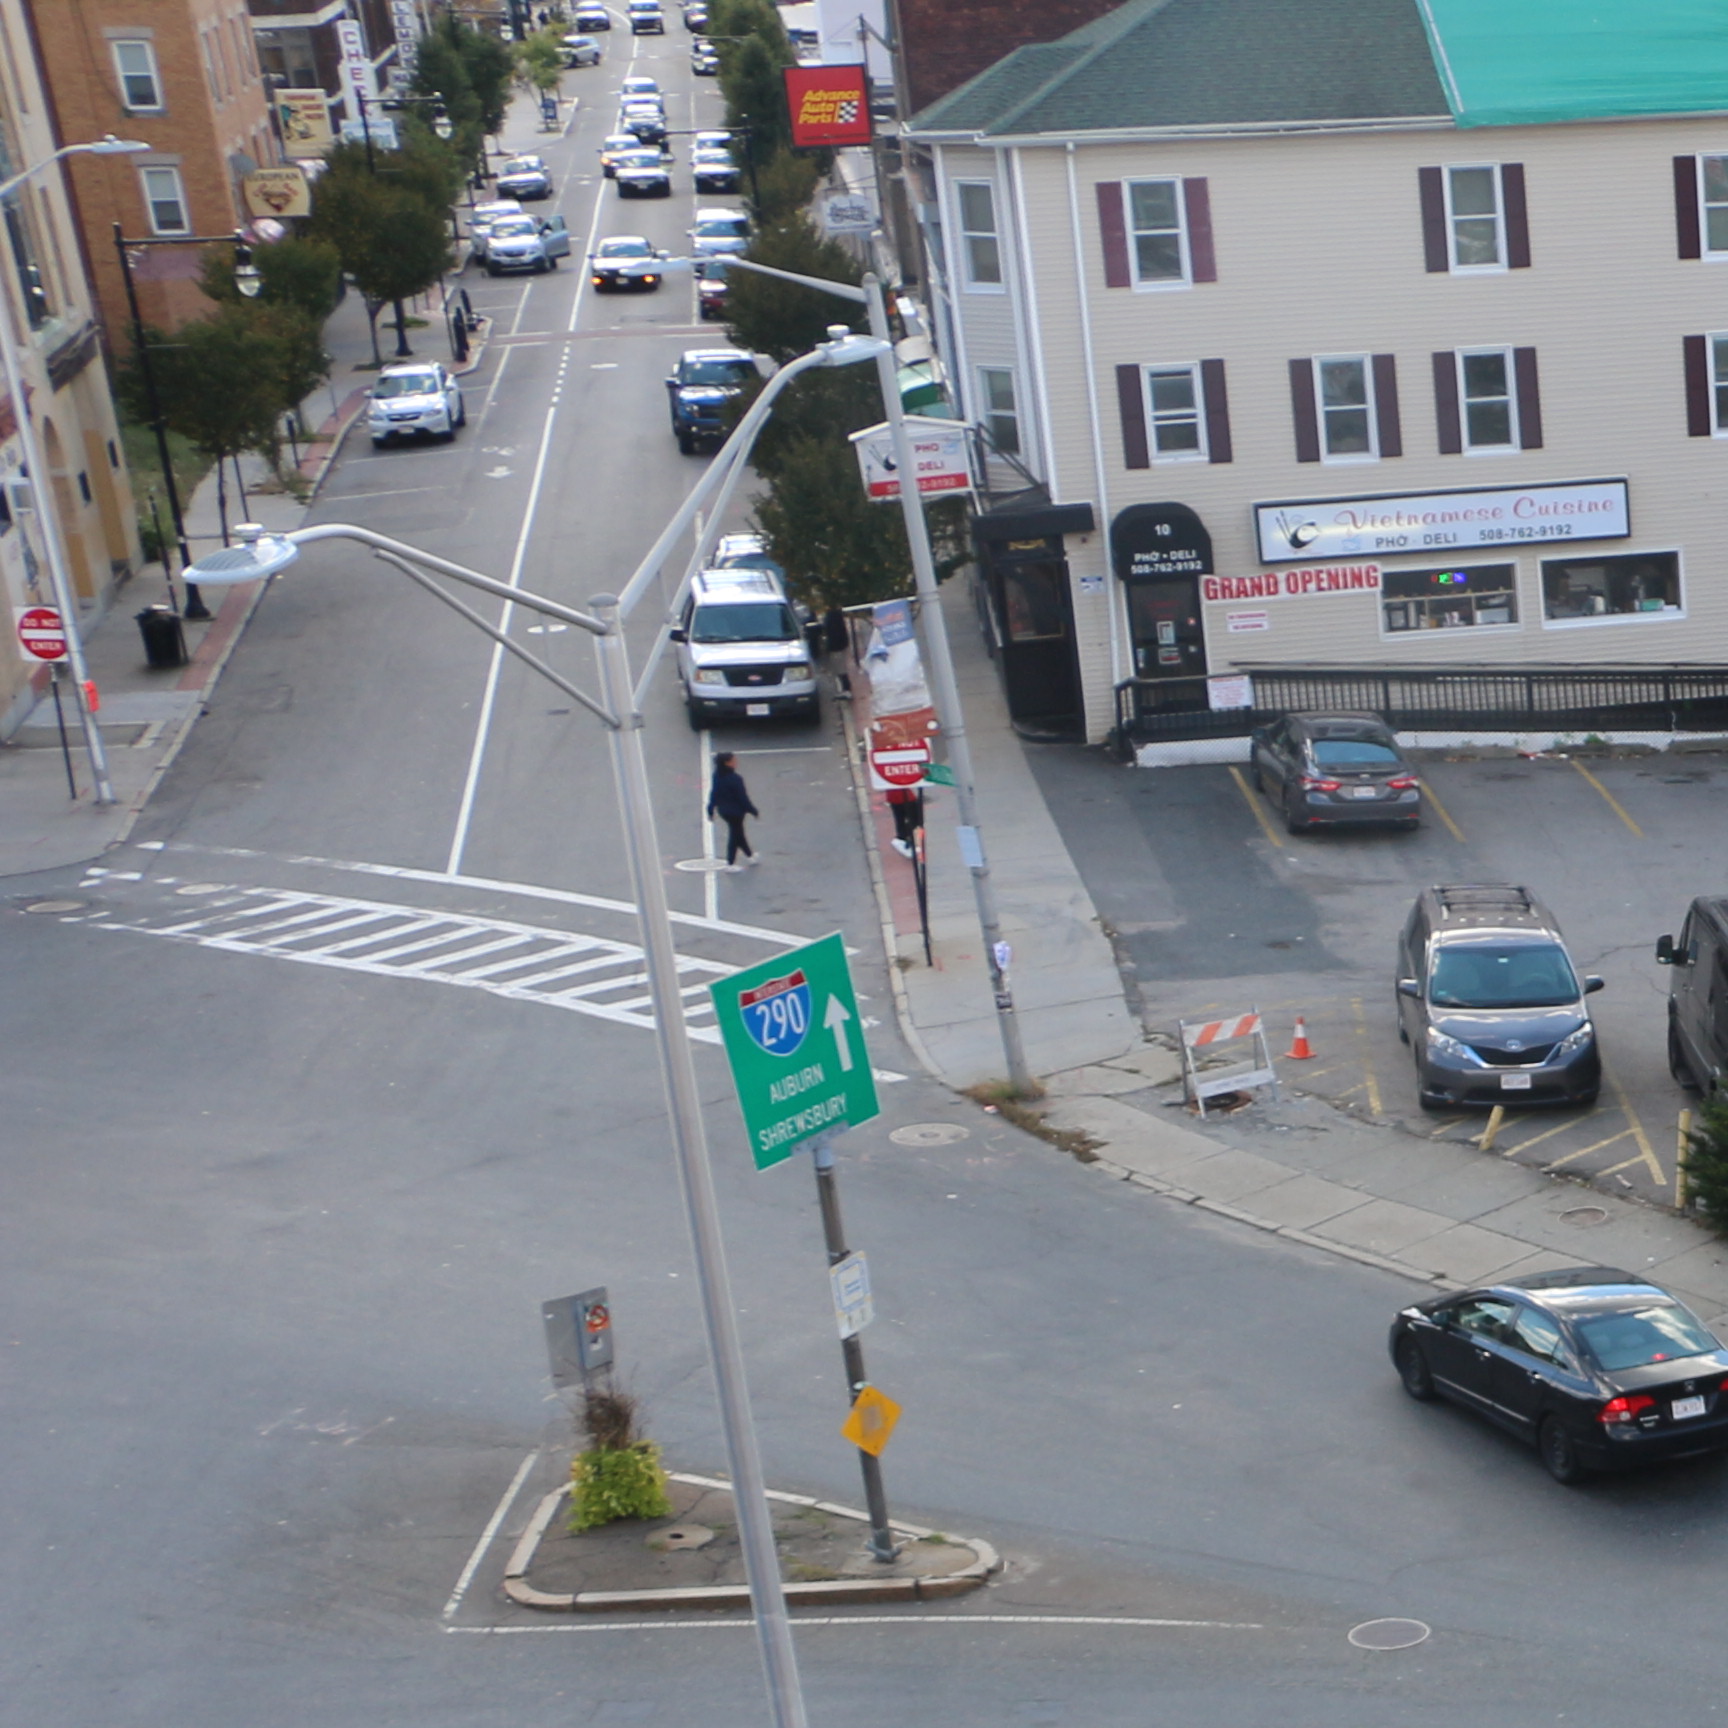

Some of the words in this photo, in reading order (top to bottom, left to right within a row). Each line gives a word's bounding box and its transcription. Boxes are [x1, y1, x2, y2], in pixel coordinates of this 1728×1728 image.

[802, 90, 861, 102] Advance
[801, 102, 835, 113] Auto
[798, 112, 833, 124] Parts
[1334, 505, 1504, 531] Vietnamese
[1512, 496, 1615, 520] Cuisine
[1154, 523, 1172, 536] 10
[1422, 532, 1458, 546] DELI
[1478, 524, 1573, 542] 508-762-9192
[1169, 549, 1198, 561] DELI
[1203, 572, 1280, 601] GRAND
[1285, 564, 1380, 595] OPENING
[884, 763, 920, 777] ENTER
[755, 992, 805, 1047] 290
[769, 1063, 826, 1105] AUBURN
[758, 1092, 848, 1152] SHREWSBURY
